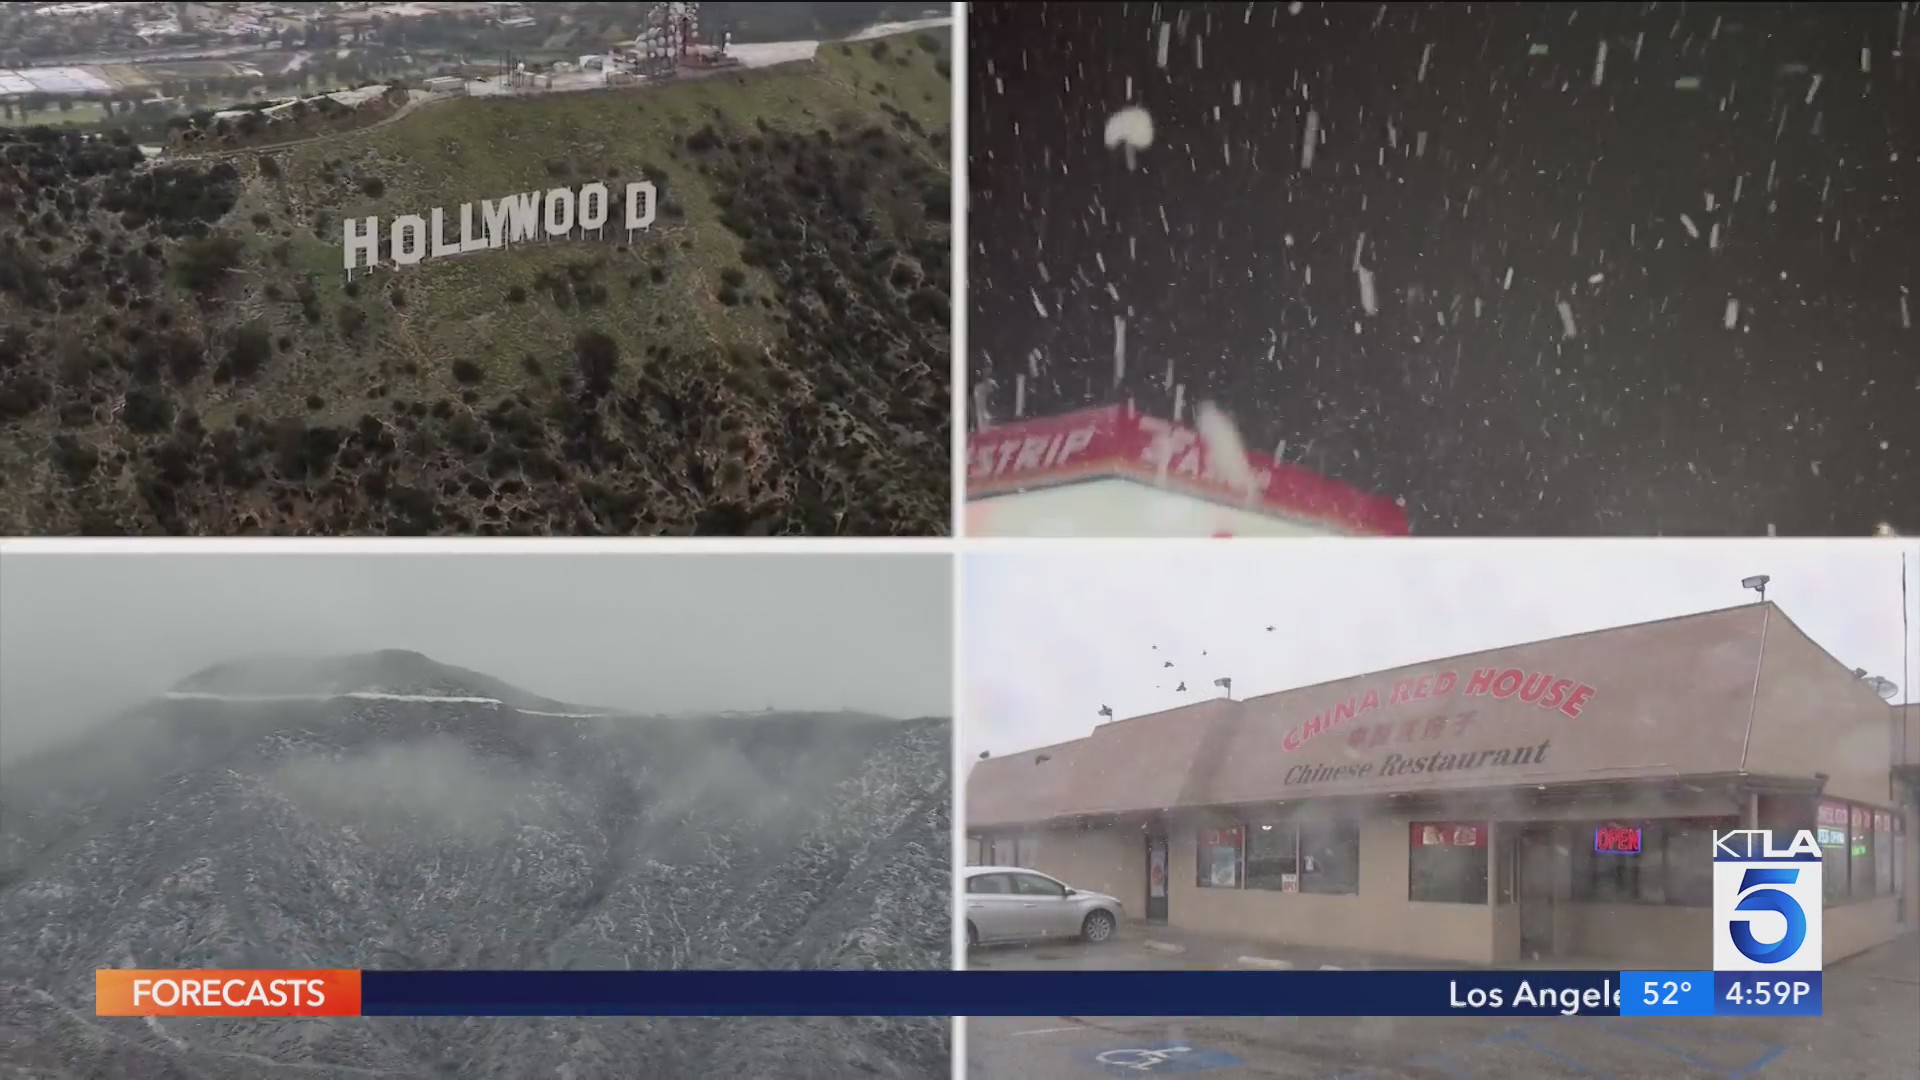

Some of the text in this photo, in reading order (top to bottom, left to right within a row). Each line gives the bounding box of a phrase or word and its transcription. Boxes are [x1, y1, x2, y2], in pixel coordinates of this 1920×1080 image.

[343, 180, 657, 272] HOLLYWOOD
[968, 424, 1096, 478] STRIP
[1282, 687, 1381, 751] CHINA
[1389, 671, 1458, 704] RED
[1465, 668, 1597, 718] HOUSE
[1284, 739, 1552, 786] Chinese Restaurant
[1597, 828, 1639, 851] OPEN
